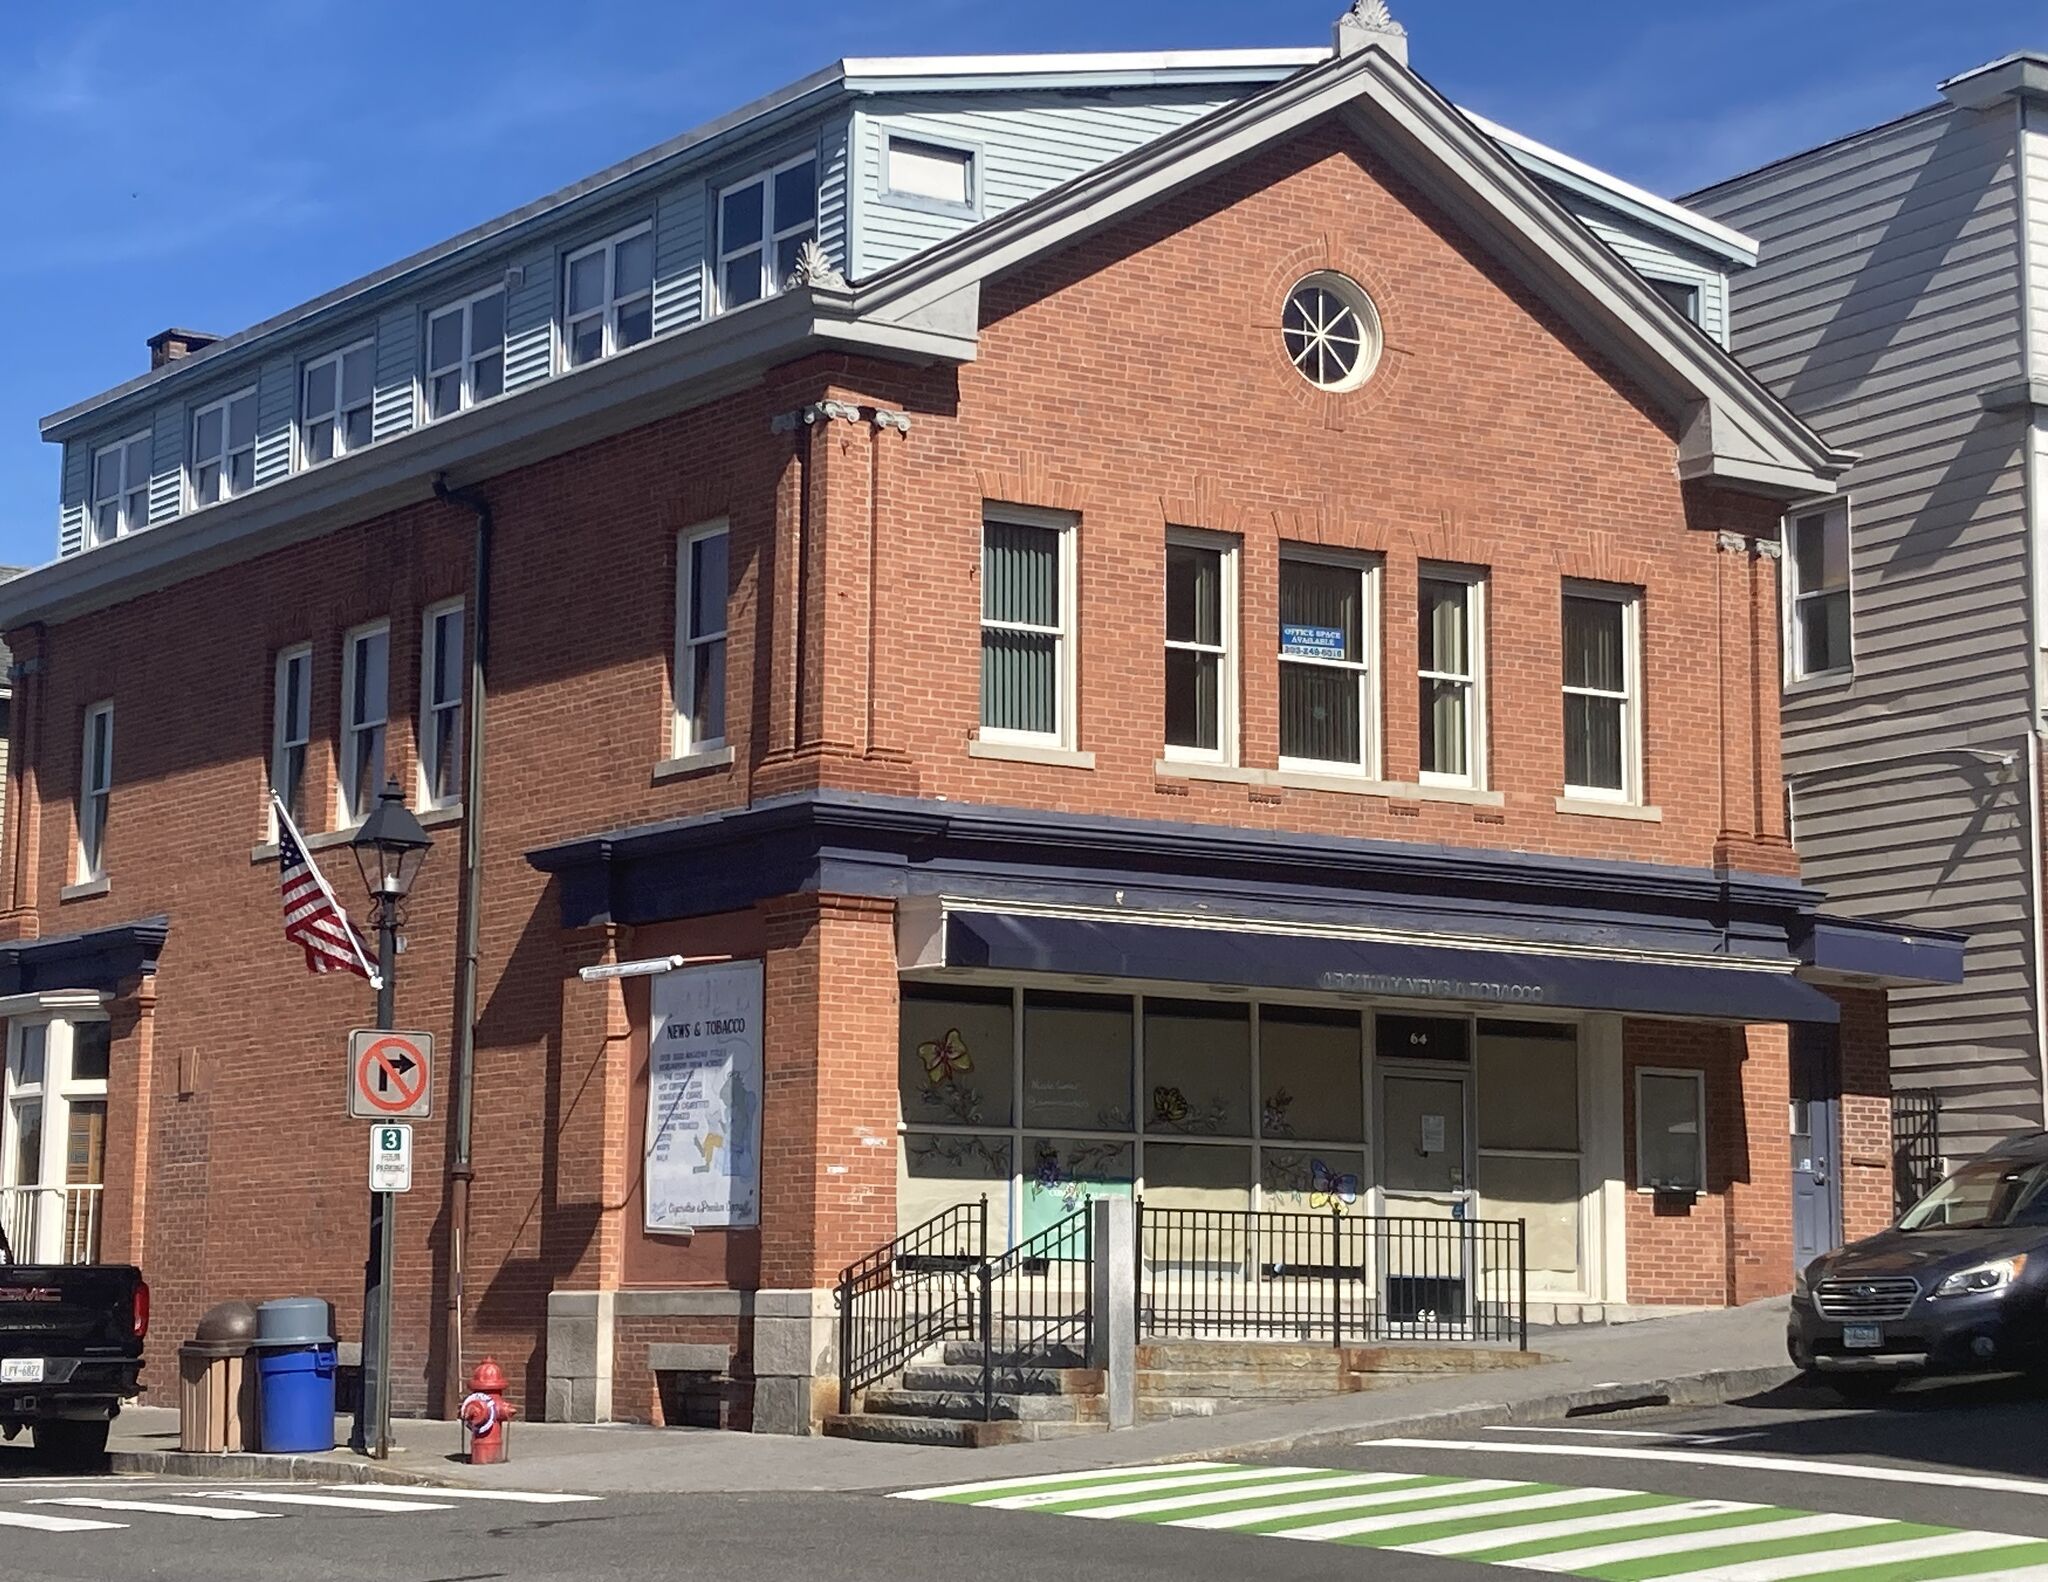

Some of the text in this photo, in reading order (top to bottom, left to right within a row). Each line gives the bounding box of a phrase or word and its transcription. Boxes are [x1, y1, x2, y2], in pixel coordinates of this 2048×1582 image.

[1284, 628, 1341, 640] OFFICE SPACE
[1291, 636, 1335, 646] AVAILABLE
[667, 1017, 746, 1040] NEWS & TOBACCO
[1410, 1033, 1428, 1045] 64
[385, 1131, 398, 1149] 3
